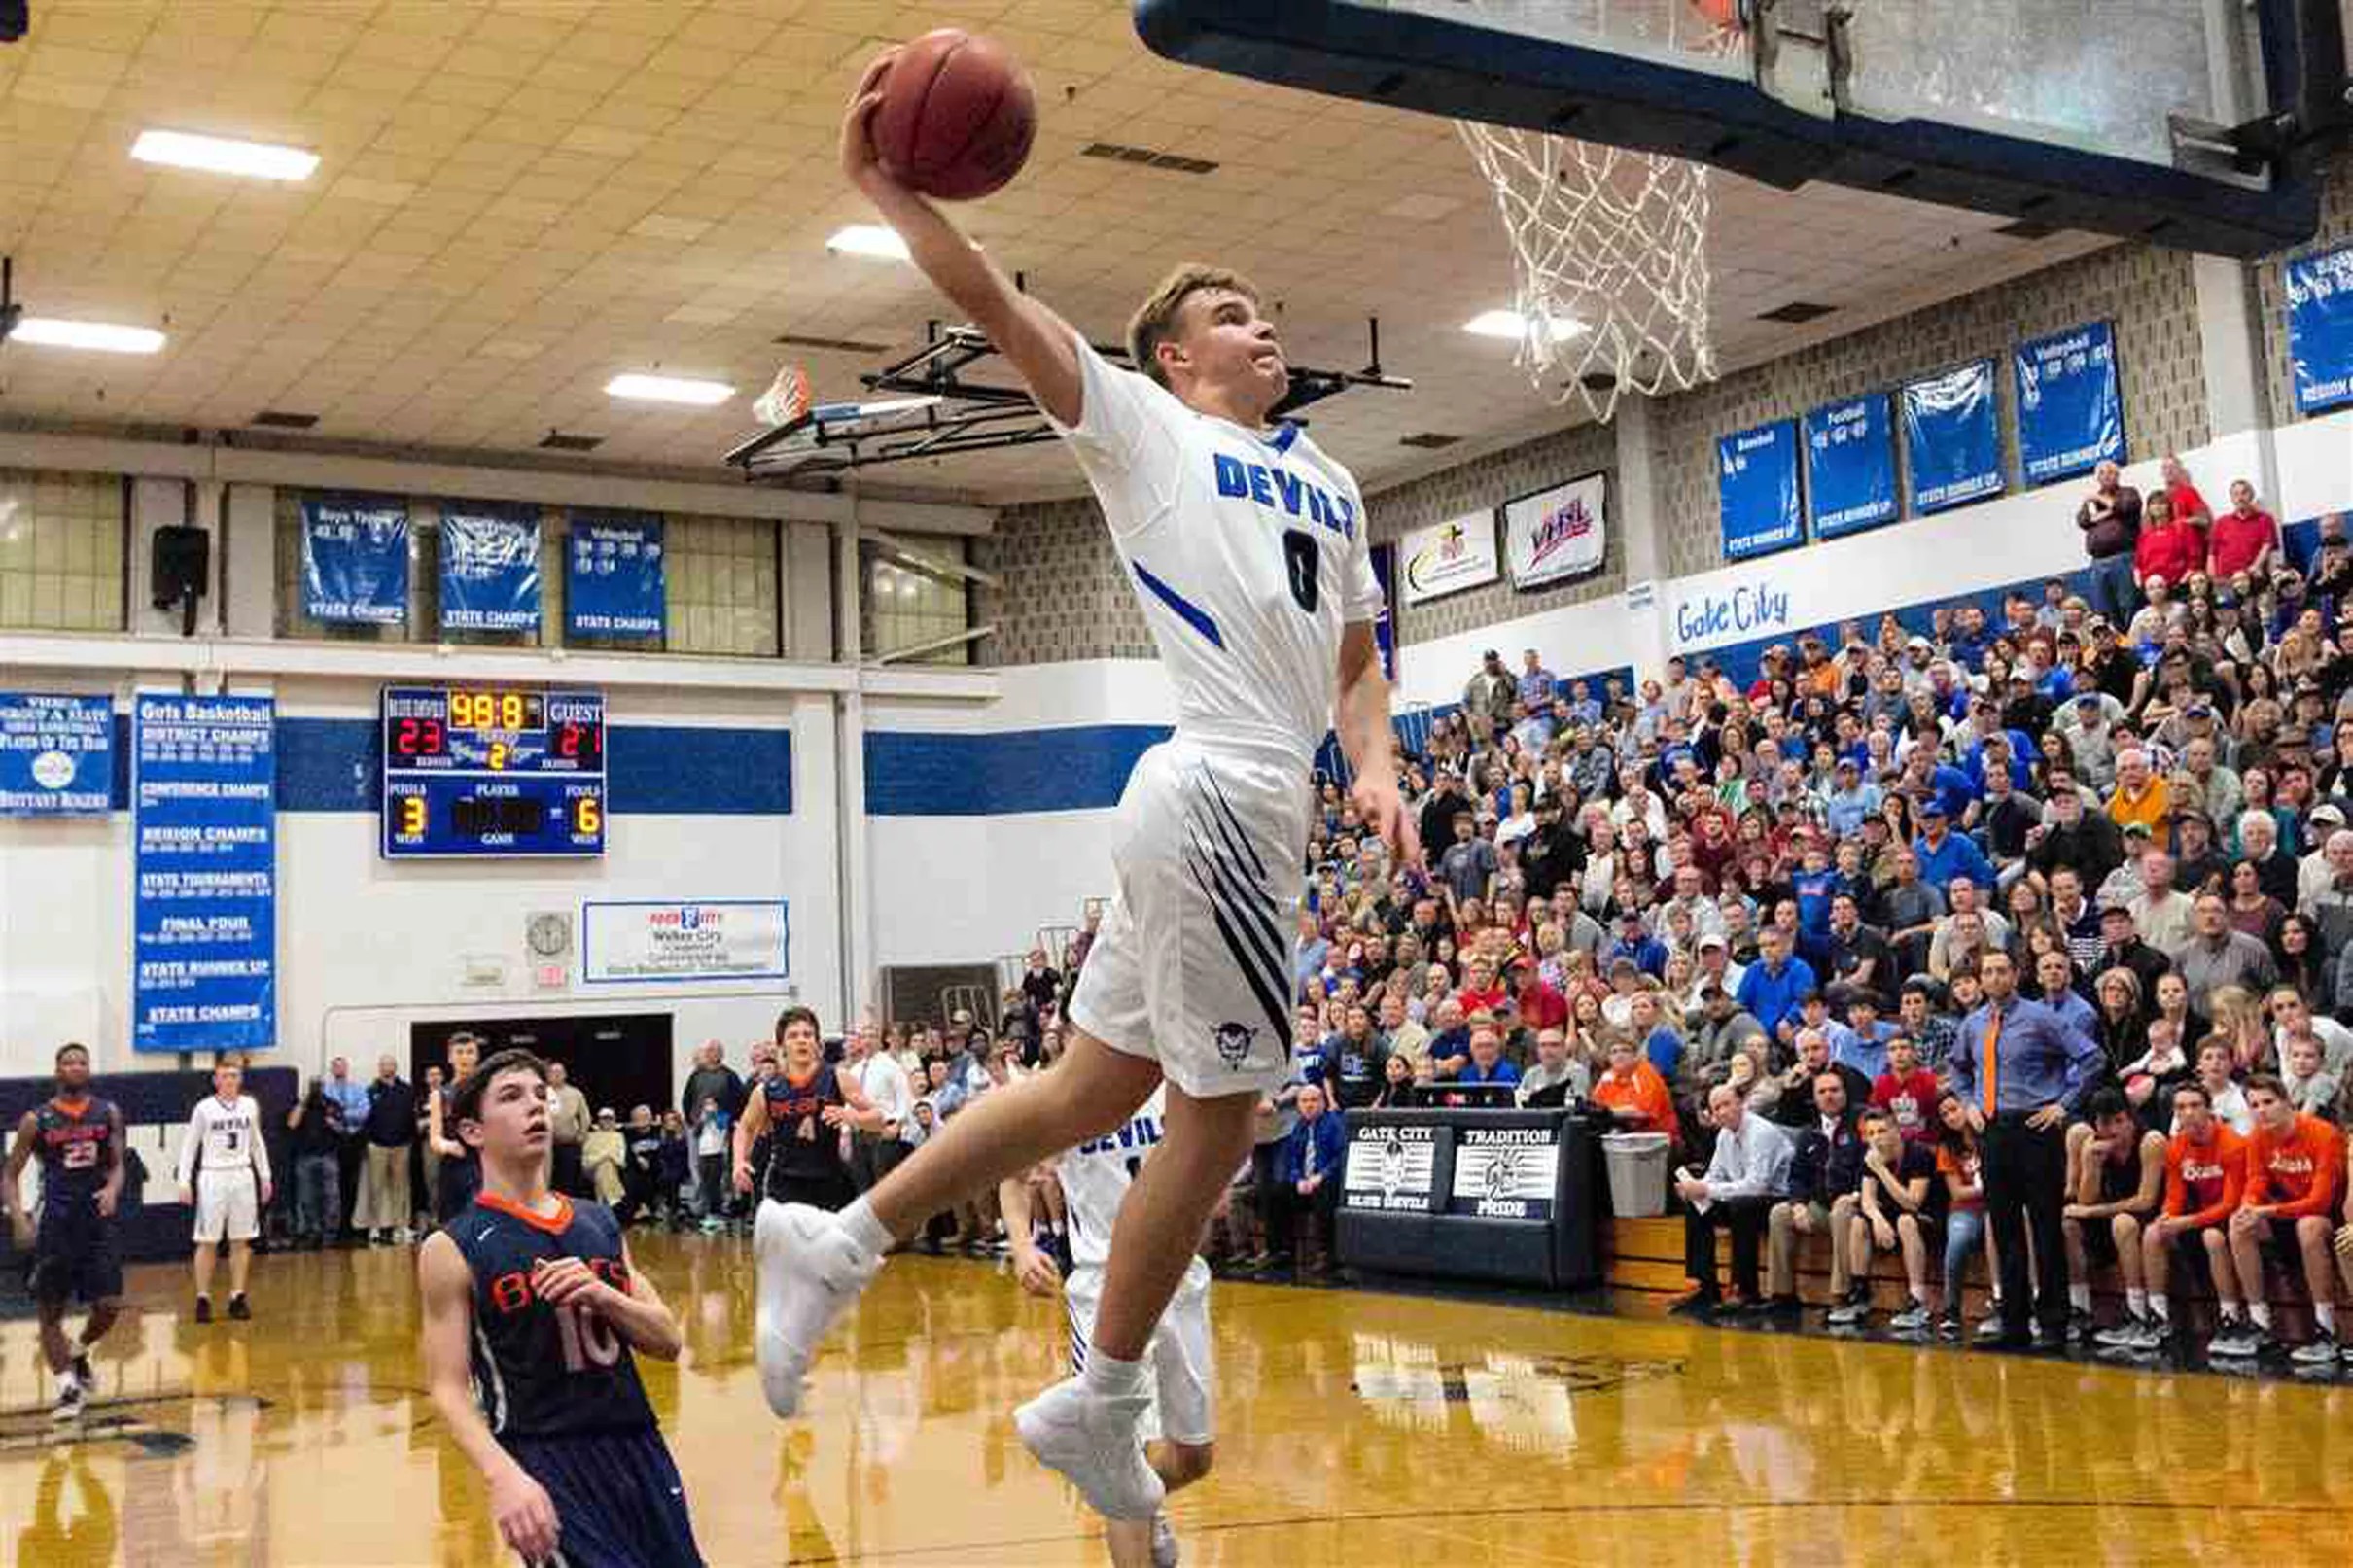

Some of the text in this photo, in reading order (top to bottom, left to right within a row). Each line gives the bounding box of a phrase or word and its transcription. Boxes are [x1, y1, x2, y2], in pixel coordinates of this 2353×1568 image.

[1213, 452, 1354, 540] DEVILS
[1282, 528, 1319, 613] 0
[576, 614, 610, 629] STATE
[1677, 596, 1730, 642] Gate
[1733, 583, 1787, 630] City
[183, 703, 271, 722] Basketball
[399, 718, 440, 753] 23
[489, 742, 506, 771] 2
[404, 796, 426, 834] 3
[578, 798, 600, 834] 6
[143, 873, 180, 888] STATE
[149, 1004, 197, 1023] STATE
[1358, 1126, 1435, 1142] GATE CITY
[1465, 1129, 1552, 1145] TRADITION
[1477, 1200, 1527, 1218] PRIDE
